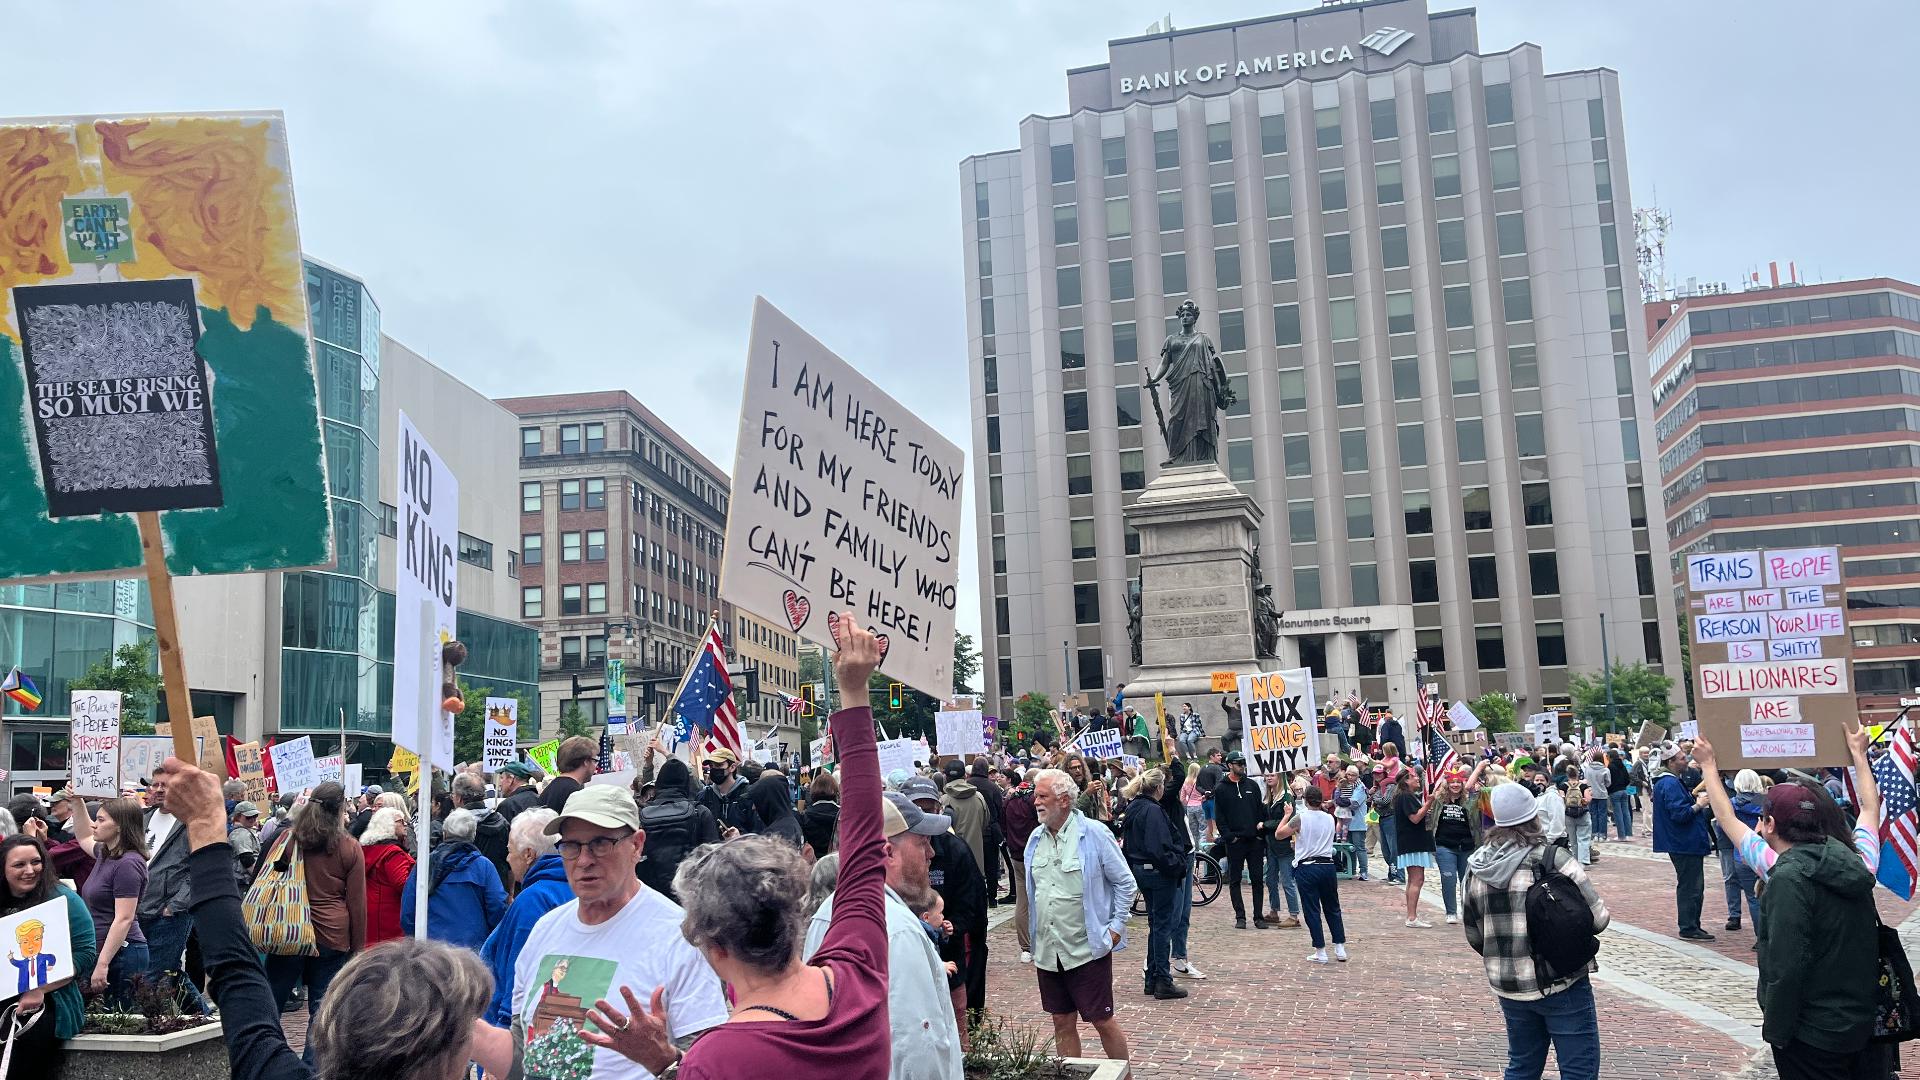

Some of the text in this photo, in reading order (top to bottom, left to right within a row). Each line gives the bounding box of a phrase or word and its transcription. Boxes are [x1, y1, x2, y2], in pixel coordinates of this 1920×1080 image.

[1120, 45, 1355, 93] BANK OF AMERICA
[72, 204, 119, 218] EARTH
[76, 232, 120, 251] WAIT
[35, 375, 200, 398] THE SEA IS RISING
[38, 389, 203, 418] SO MUST WE
[772, 340, 962, 500] I AM HERE TODAY
[404, 428, 432, 515] NO
[761, 410, 951, 563] FOR MY FRIENDS
[753, 466, 956, 611] AND FAMILY WHO
[406, 503, 453, 607] KING
[1690, 555, 1832, 583] TRANS PEOPLE
[748, 525, 931, 651] CAN'T BE HERE!
[1709, 589, 1820, 609] ARE NOT THE
[1333, 615, 1371, 627] Square
[1699, 612, 1840, 640] REASON YOUR LIFE
[1734, 644, 1752, 659] IS
[1251, 674, 1285, 701] NO
[1703, 665, 1838, 694] BILLIONAIRES
[72, 696, 118, 715] THE POWER OF
[1248, 695, 1303, 726] FAUX
[1754, 701, 1791, 720] ARE
[82, 715, 109, 733] PEOPLE
[111, 717, 118, 727] IS
[493, 727, 508, 736] NO
[73, 734, 119, 751] STRONGER
[486, 738, 513, 747] KINGS
[1084, 730, 1116, 747] DUMP
[1250, 723, 1306, 751] KING
[74, 752, 110, 764] THAN THE
[487, 748, 512, 757] SINCE
[1082, 742, 1121, 759] TRUMP
[1750, 744, 1786, 754] WRONG
[489, 758, 509, 767] 1776
[1254, 746, 1308, 774] WAY!
[78, 765, 101, 777] PEOPLE
[76, 775, 116, 790] IN POWER
